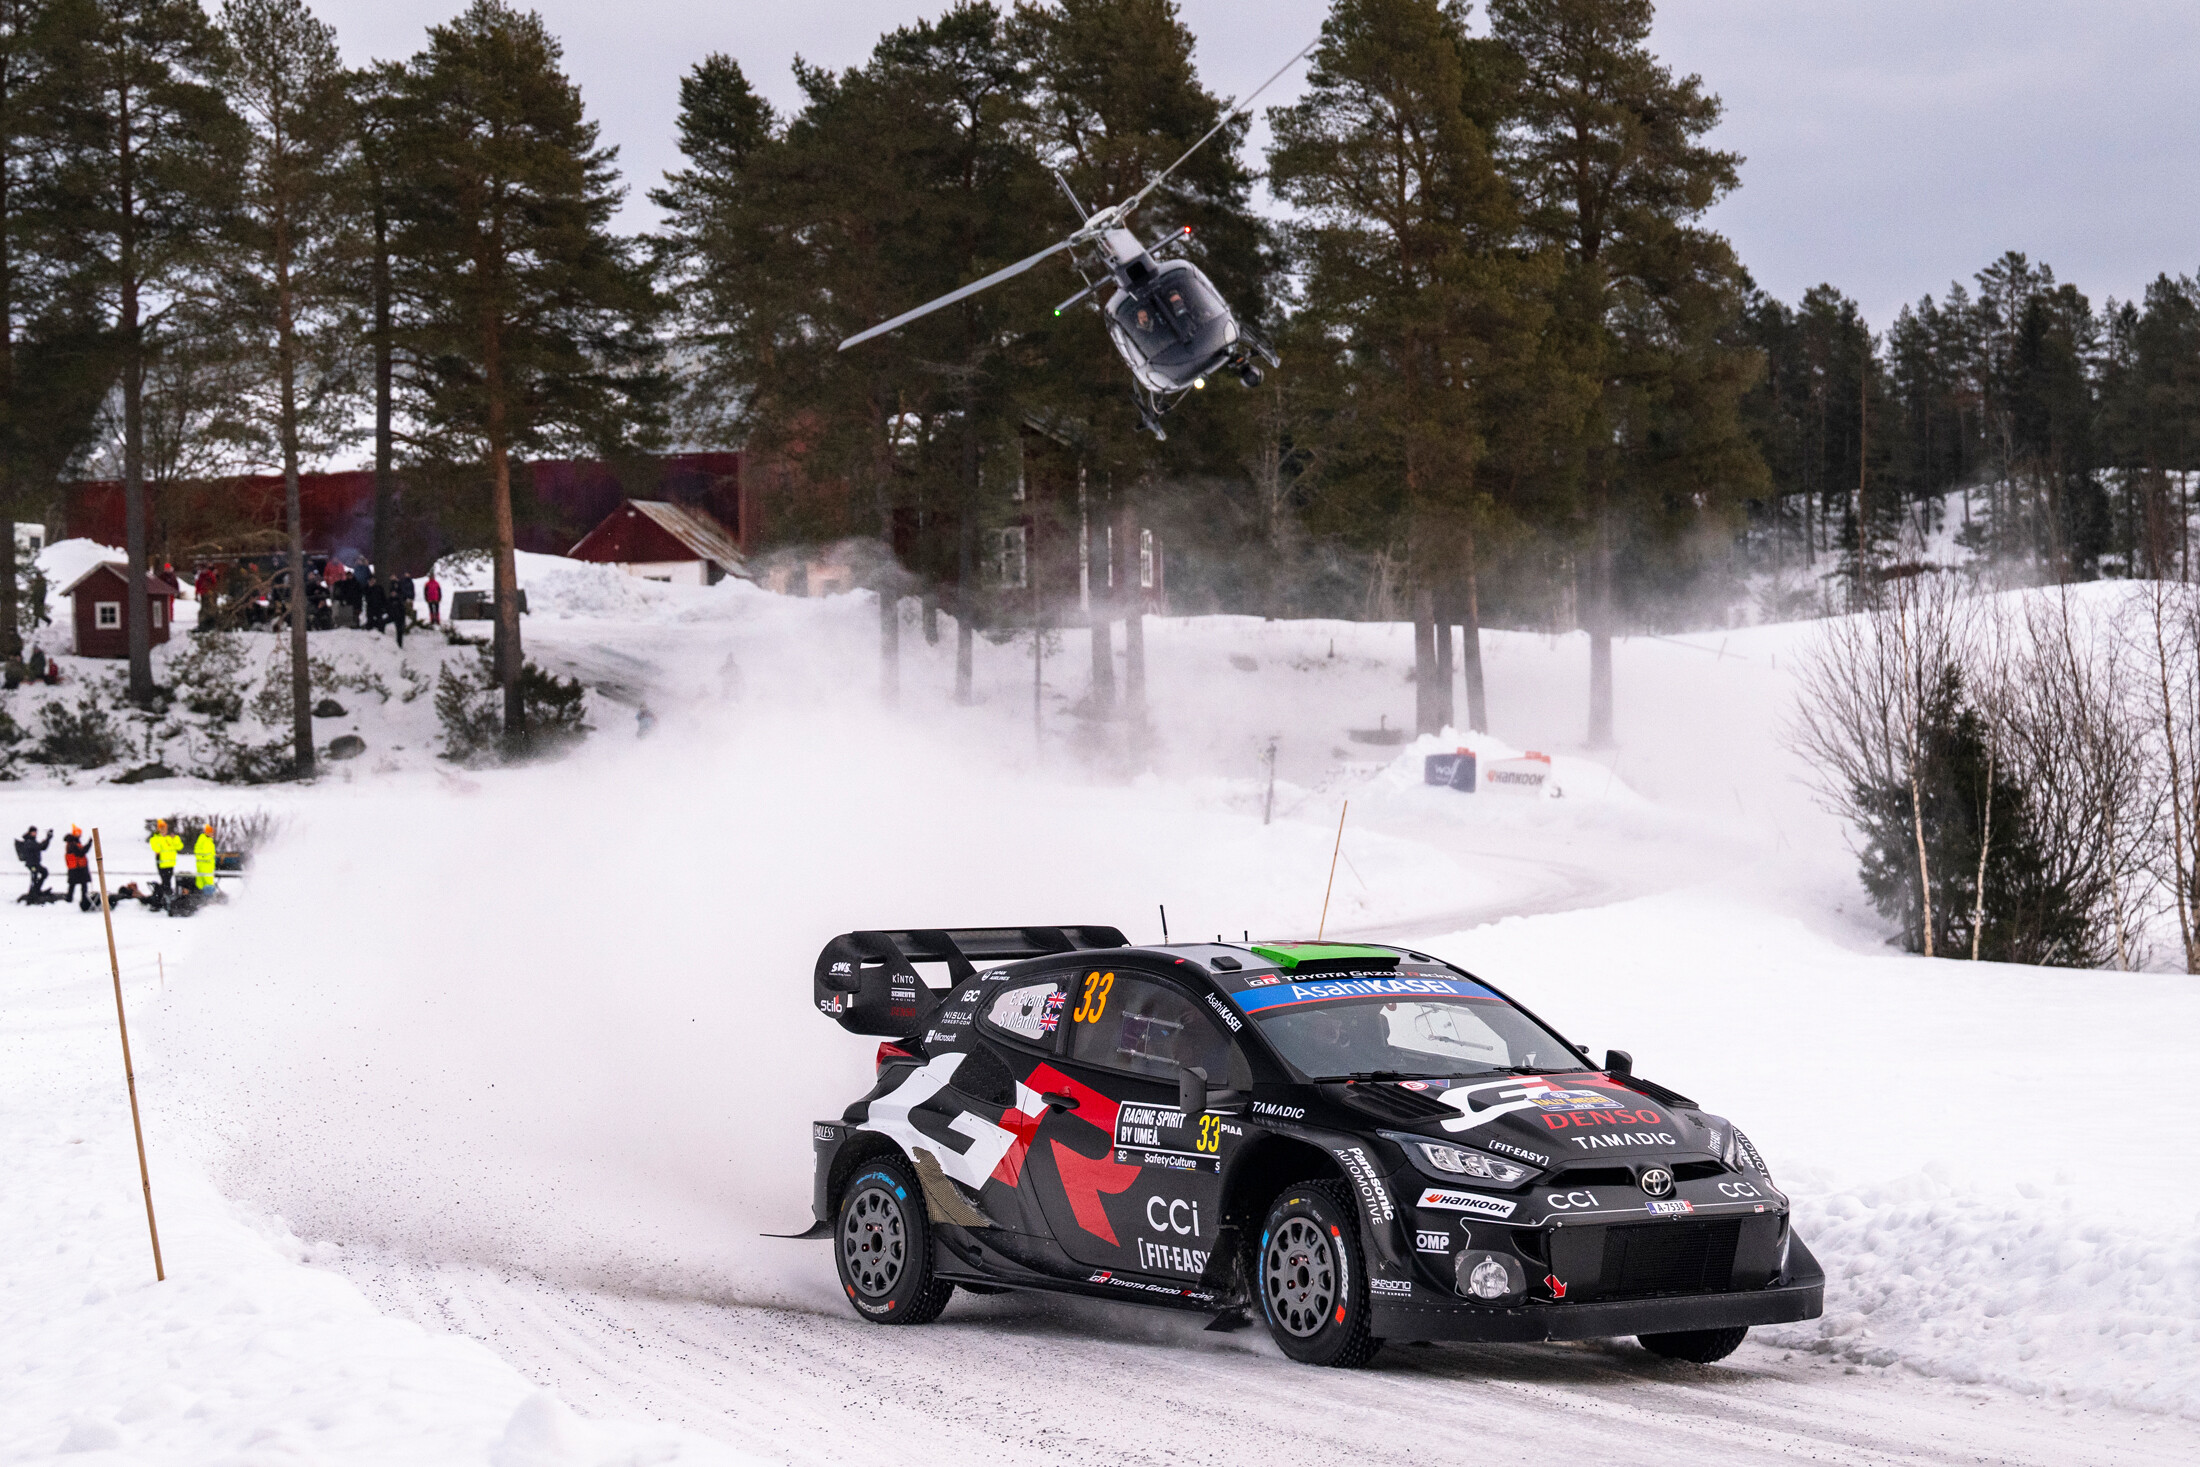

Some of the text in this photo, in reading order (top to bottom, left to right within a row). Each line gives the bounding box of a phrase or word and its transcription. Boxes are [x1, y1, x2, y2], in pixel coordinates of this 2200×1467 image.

[831, 962, 852, 973] SWS
[1249, 970, 1458, 987] GR TOYOTA GAZOO Racing
[1073, 971, 1115, 1024] 33
[1291, 980, 1459, 1000] AsahiKASEI
[820, 995, 843, 1013] Stilo
[891, 1006, 916, 1017] DENSO
[1205, 992, 1243, 1032] AsahiKASEI
[943, 1011, 972, 1021] NISULA
[933, 1033, 957, 1042] Microsoft
[1122, 1107, 1187, 1128] RACING SPIRIT
[1252, 1101, 1305, 1119] TAMADIC
[1541, 1109, 1661, 1130] DENSO
[1121, 1126, 1134, 1142] BY
[1196, 1115, 1220, 1152] 33
[1220, 1123, 1243, 1136] PIAA
[1571, 1132, 1676, 1150] TAMADIC
[1117, 1150, 1128, 1160] SC
[1144, 1153, 1197, 1168] SafetyCulture
[1333, 1149, 1383, 1225] AUTOMOTIVE
[1347, 1147, 1394, 1221] Panasonic
[1657, 1202, 1686, 1212] A-7538
[1416, 1234, 1450, 1250] OMP
[1108, 1278, 1146, 1290] TOYOTA
[1145, 1284, 1182, 1296] GAZOO
[1180, 1290, 1214, 1301] Racing
